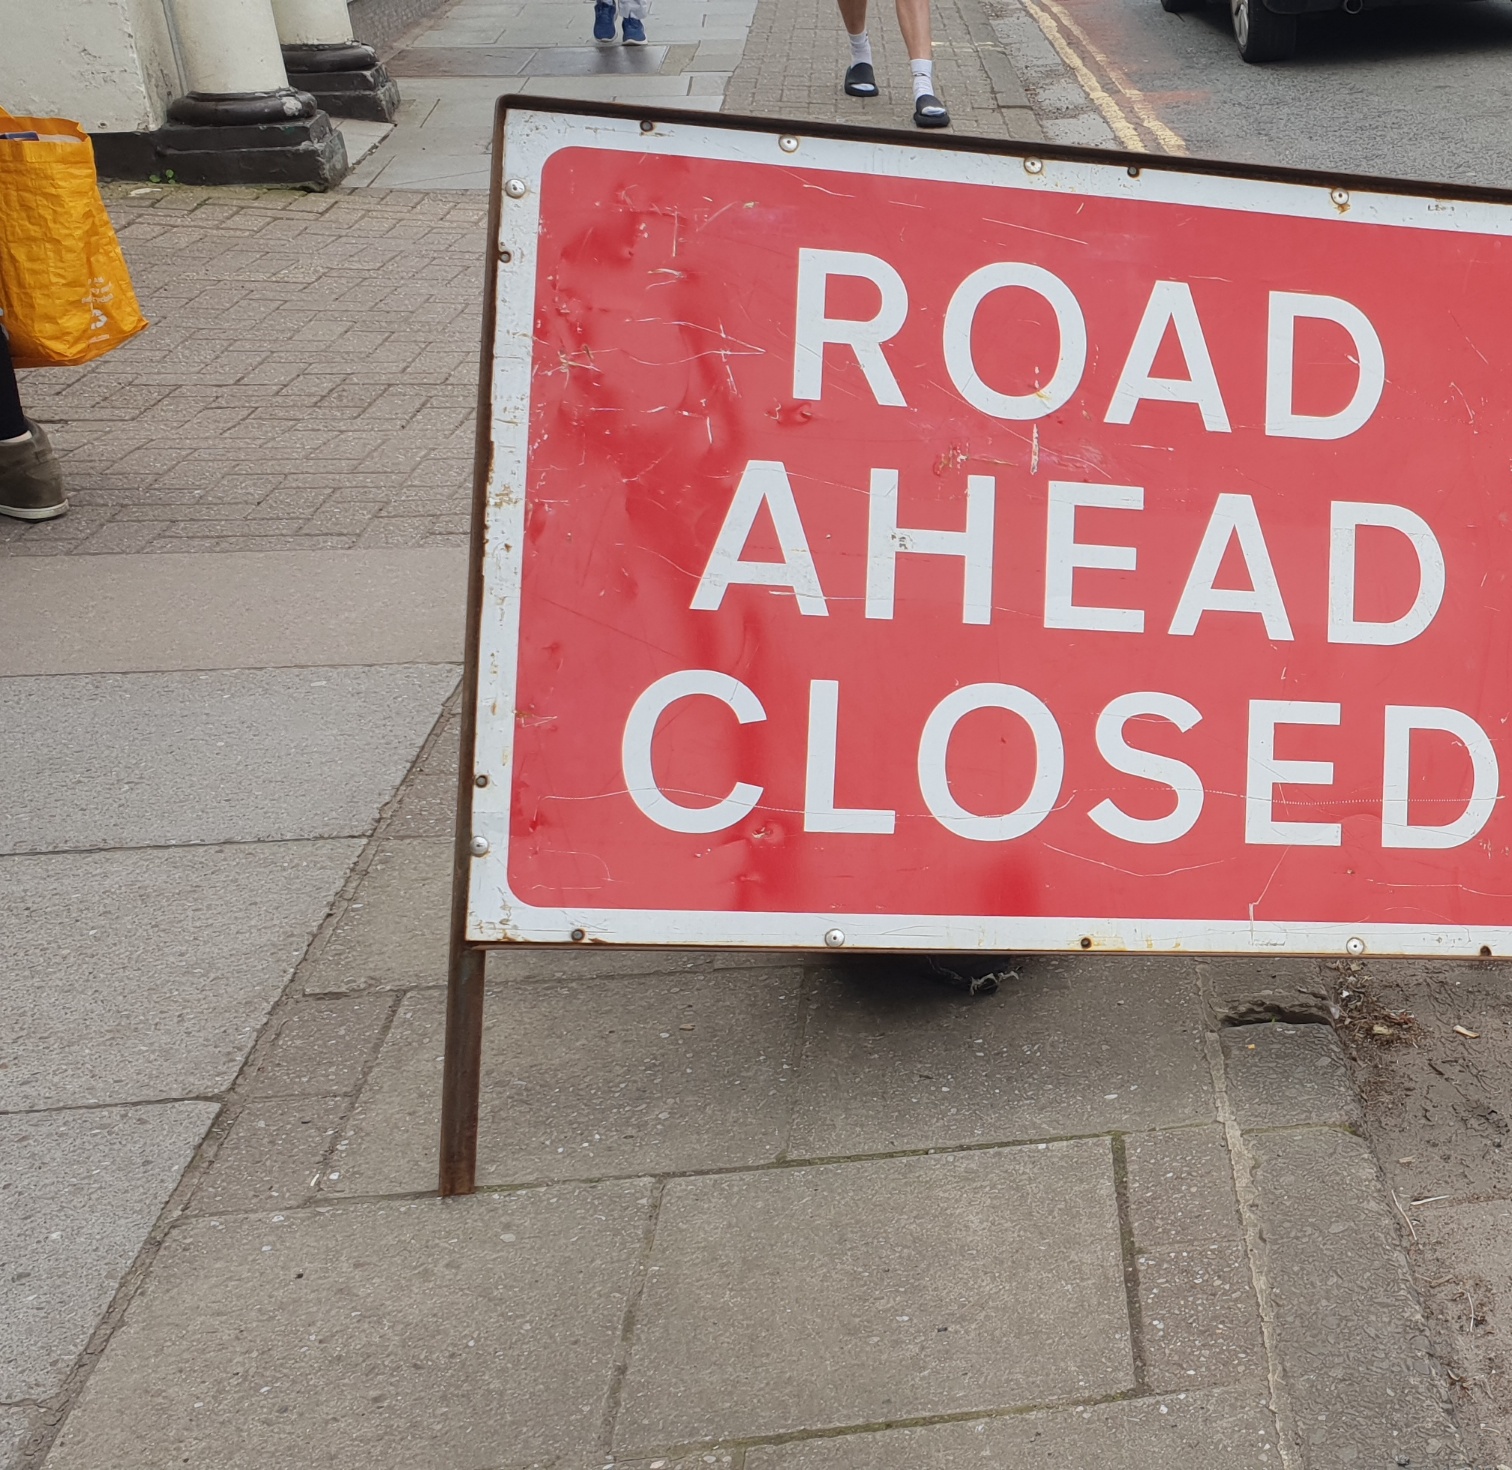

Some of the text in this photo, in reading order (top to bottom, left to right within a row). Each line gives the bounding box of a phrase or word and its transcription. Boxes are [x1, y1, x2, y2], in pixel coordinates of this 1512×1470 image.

[791, 247, 1388, 441] ROAD
[688, 459, 1446, 646] AHEAD
[619, 669, 1502, 849] CLOSED
